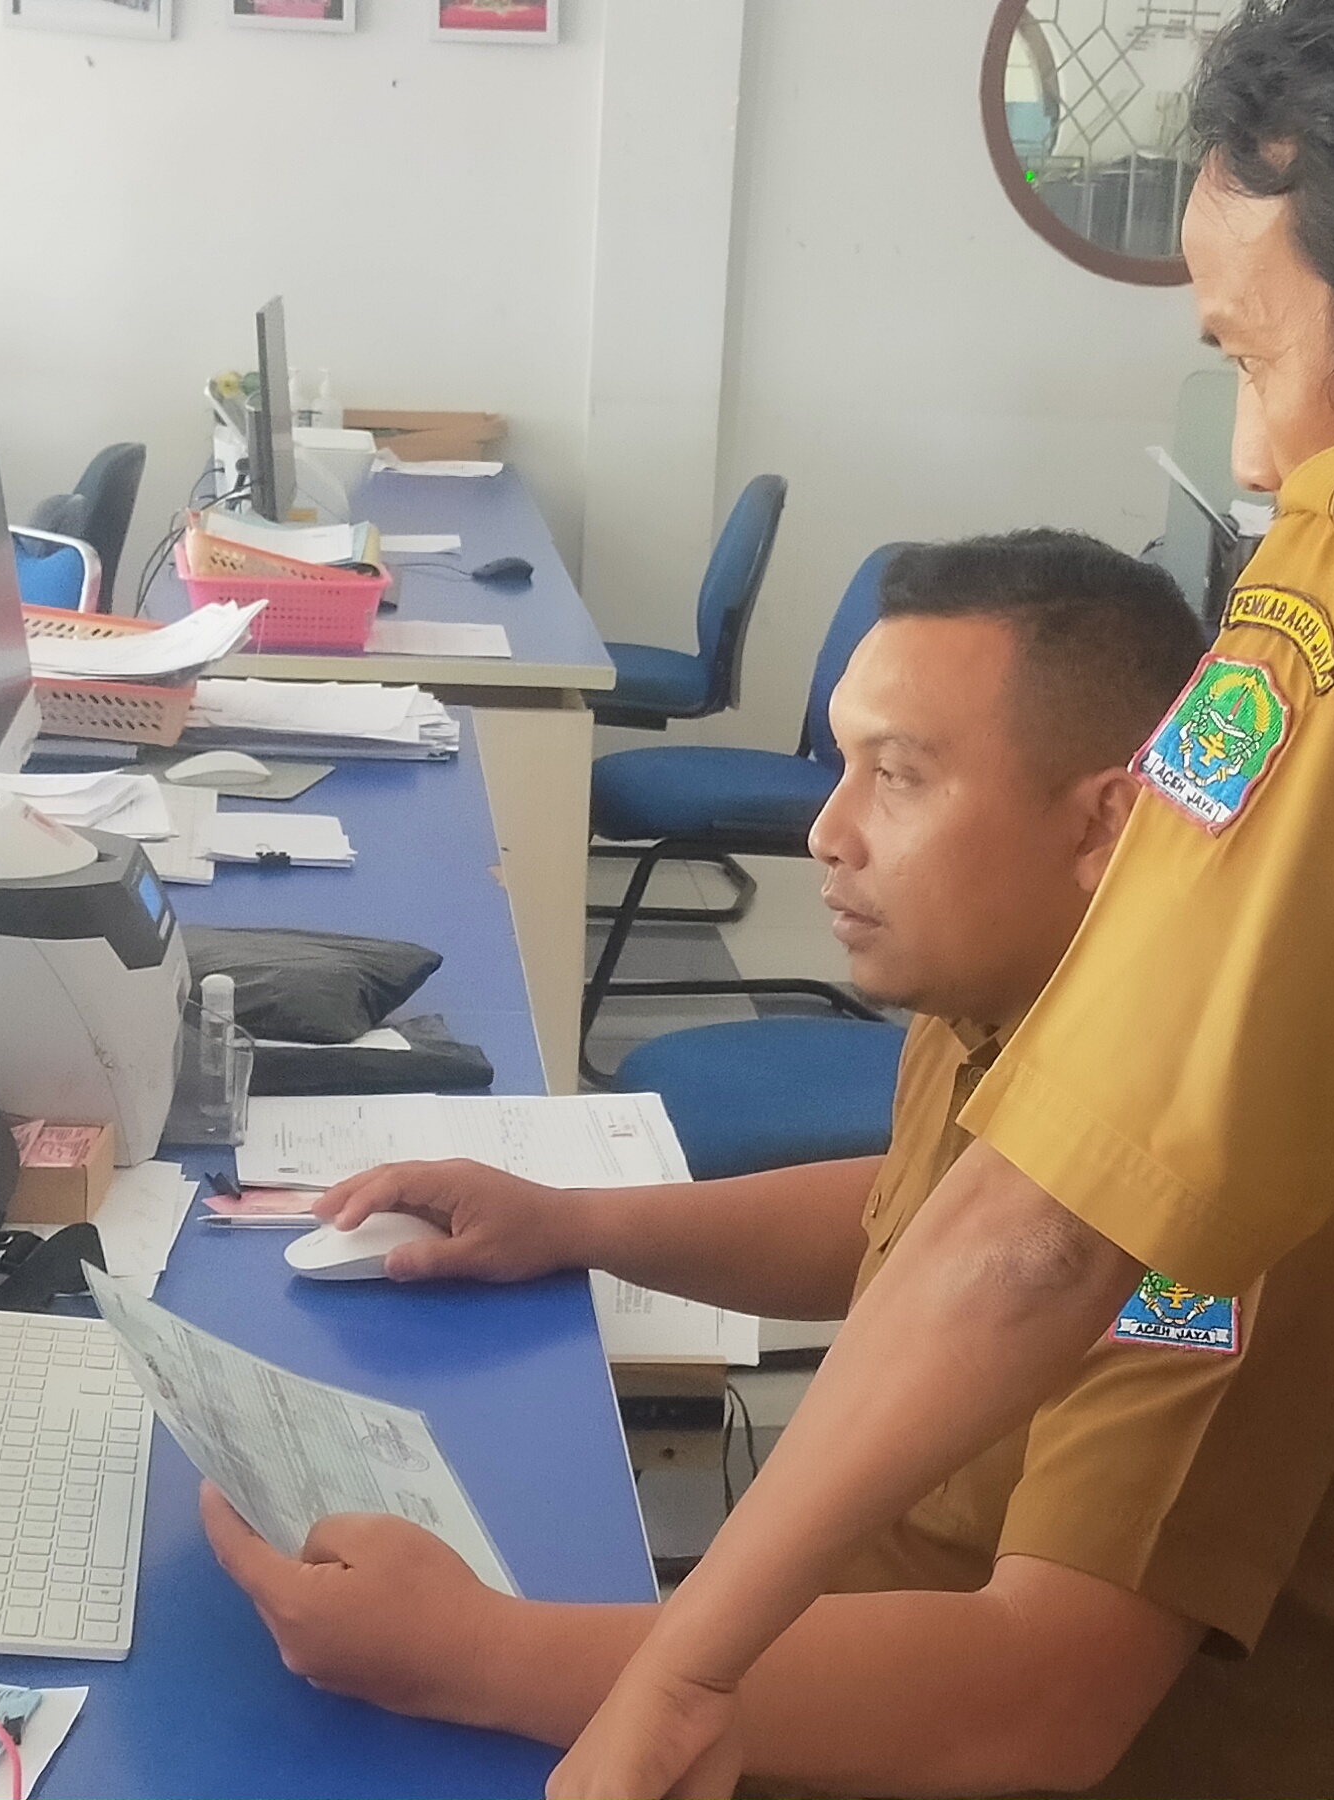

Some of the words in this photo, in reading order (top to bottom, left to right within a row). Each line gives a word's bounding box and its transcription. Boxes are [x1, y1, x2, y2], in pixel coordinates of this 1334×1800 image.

[1234, 595, 1287, 620] PEMKAB
[1282, 605, 1321, 646] ACEH
[1155, 764, 1187, 794] ACEH
[1187, 791, 1215, 816] JAYA
[1135, 1323, 1171, 1337] ACEH
[1176, 1327, 1211, 1342] JAYA
